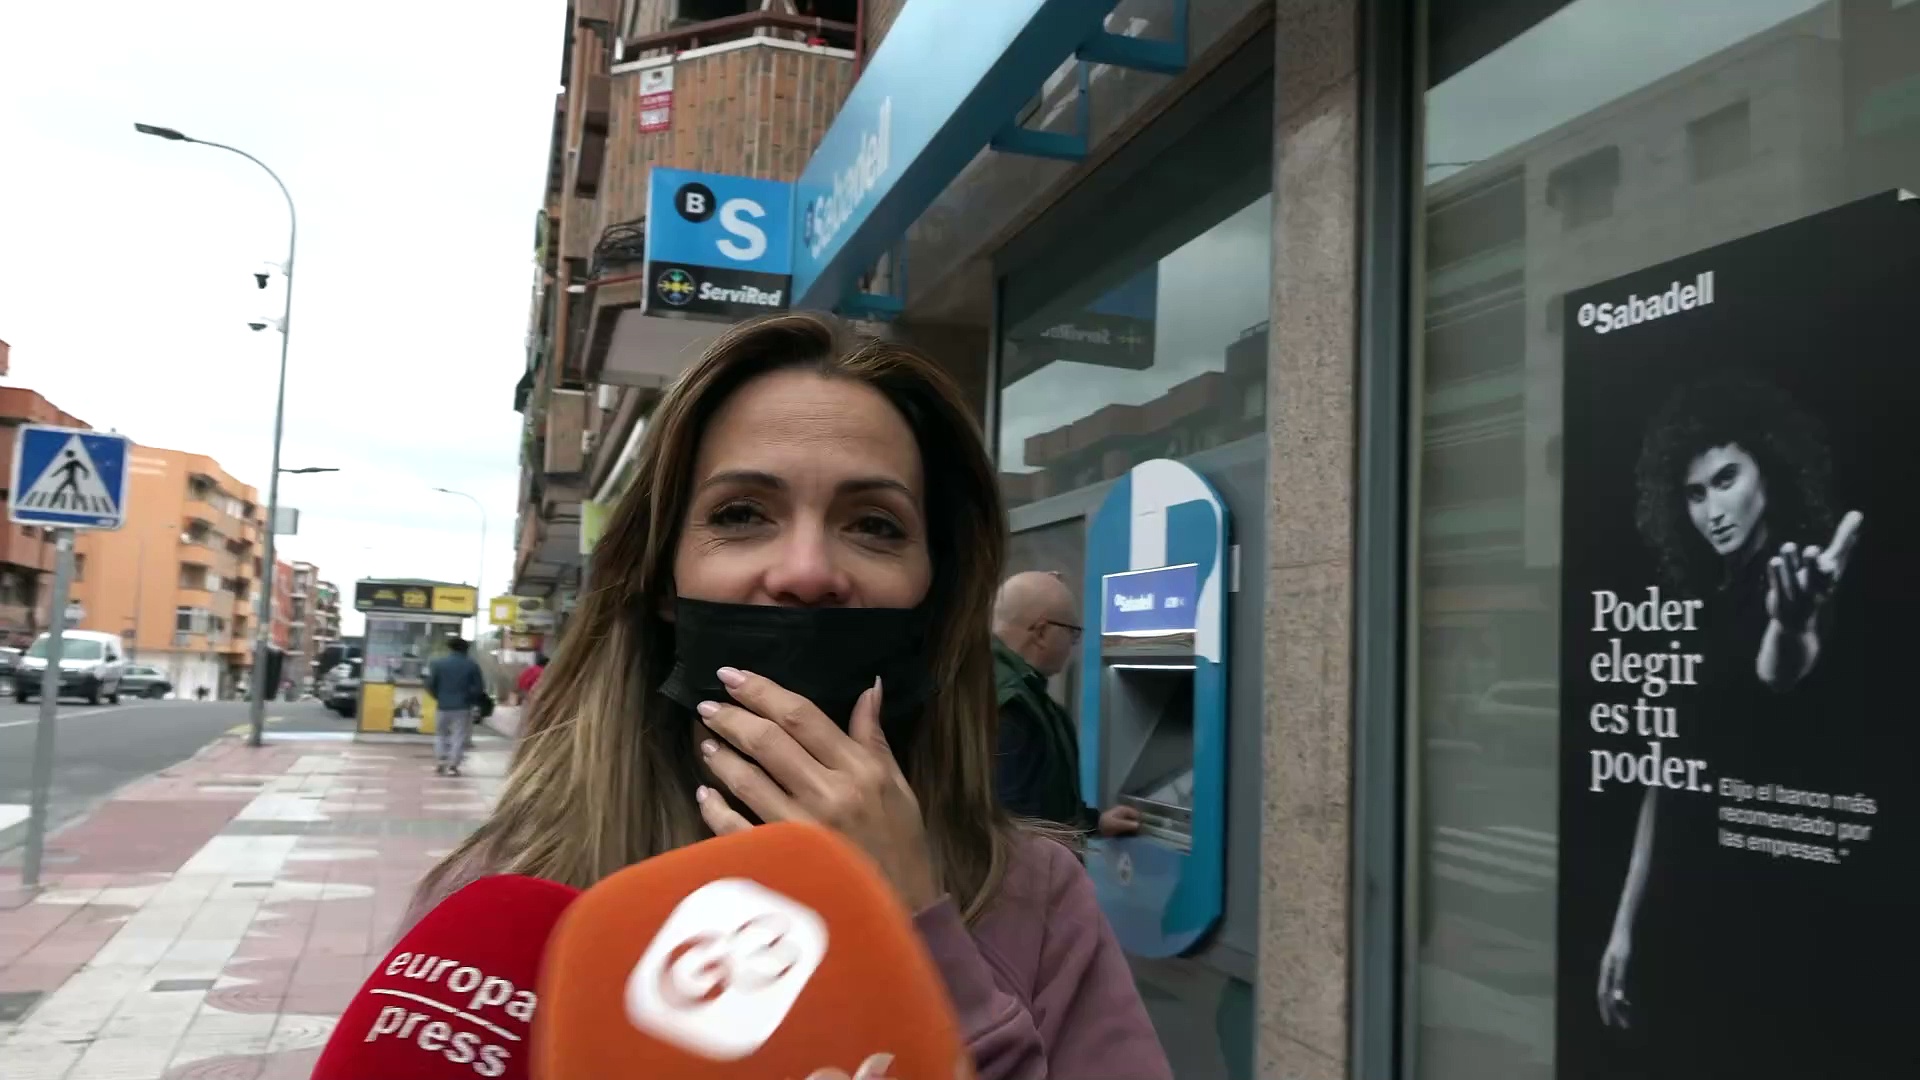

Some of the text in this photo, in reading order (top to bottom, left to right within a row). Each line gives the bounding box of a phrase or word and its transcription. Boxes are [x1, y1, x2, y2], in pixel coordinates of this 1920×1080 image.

[685, 191, 767, 261] B S
[698, 281, 783, 306] ServiRed
[1594, 270, 1715, 334] Sabadell
[1591, 586, 1704, 632] Poder
[1590, 638, 1704, 697] elegir
[1590, 698, 1680, 738] es tu
[1590, 742, 1712, 792] poder.
[1776, 784, 1831, 808] banco
[1719, 806, 1873, 841] recomendado por
[385, 952, 539, 1023] europa
[363, 1005, 512, 1077] press
